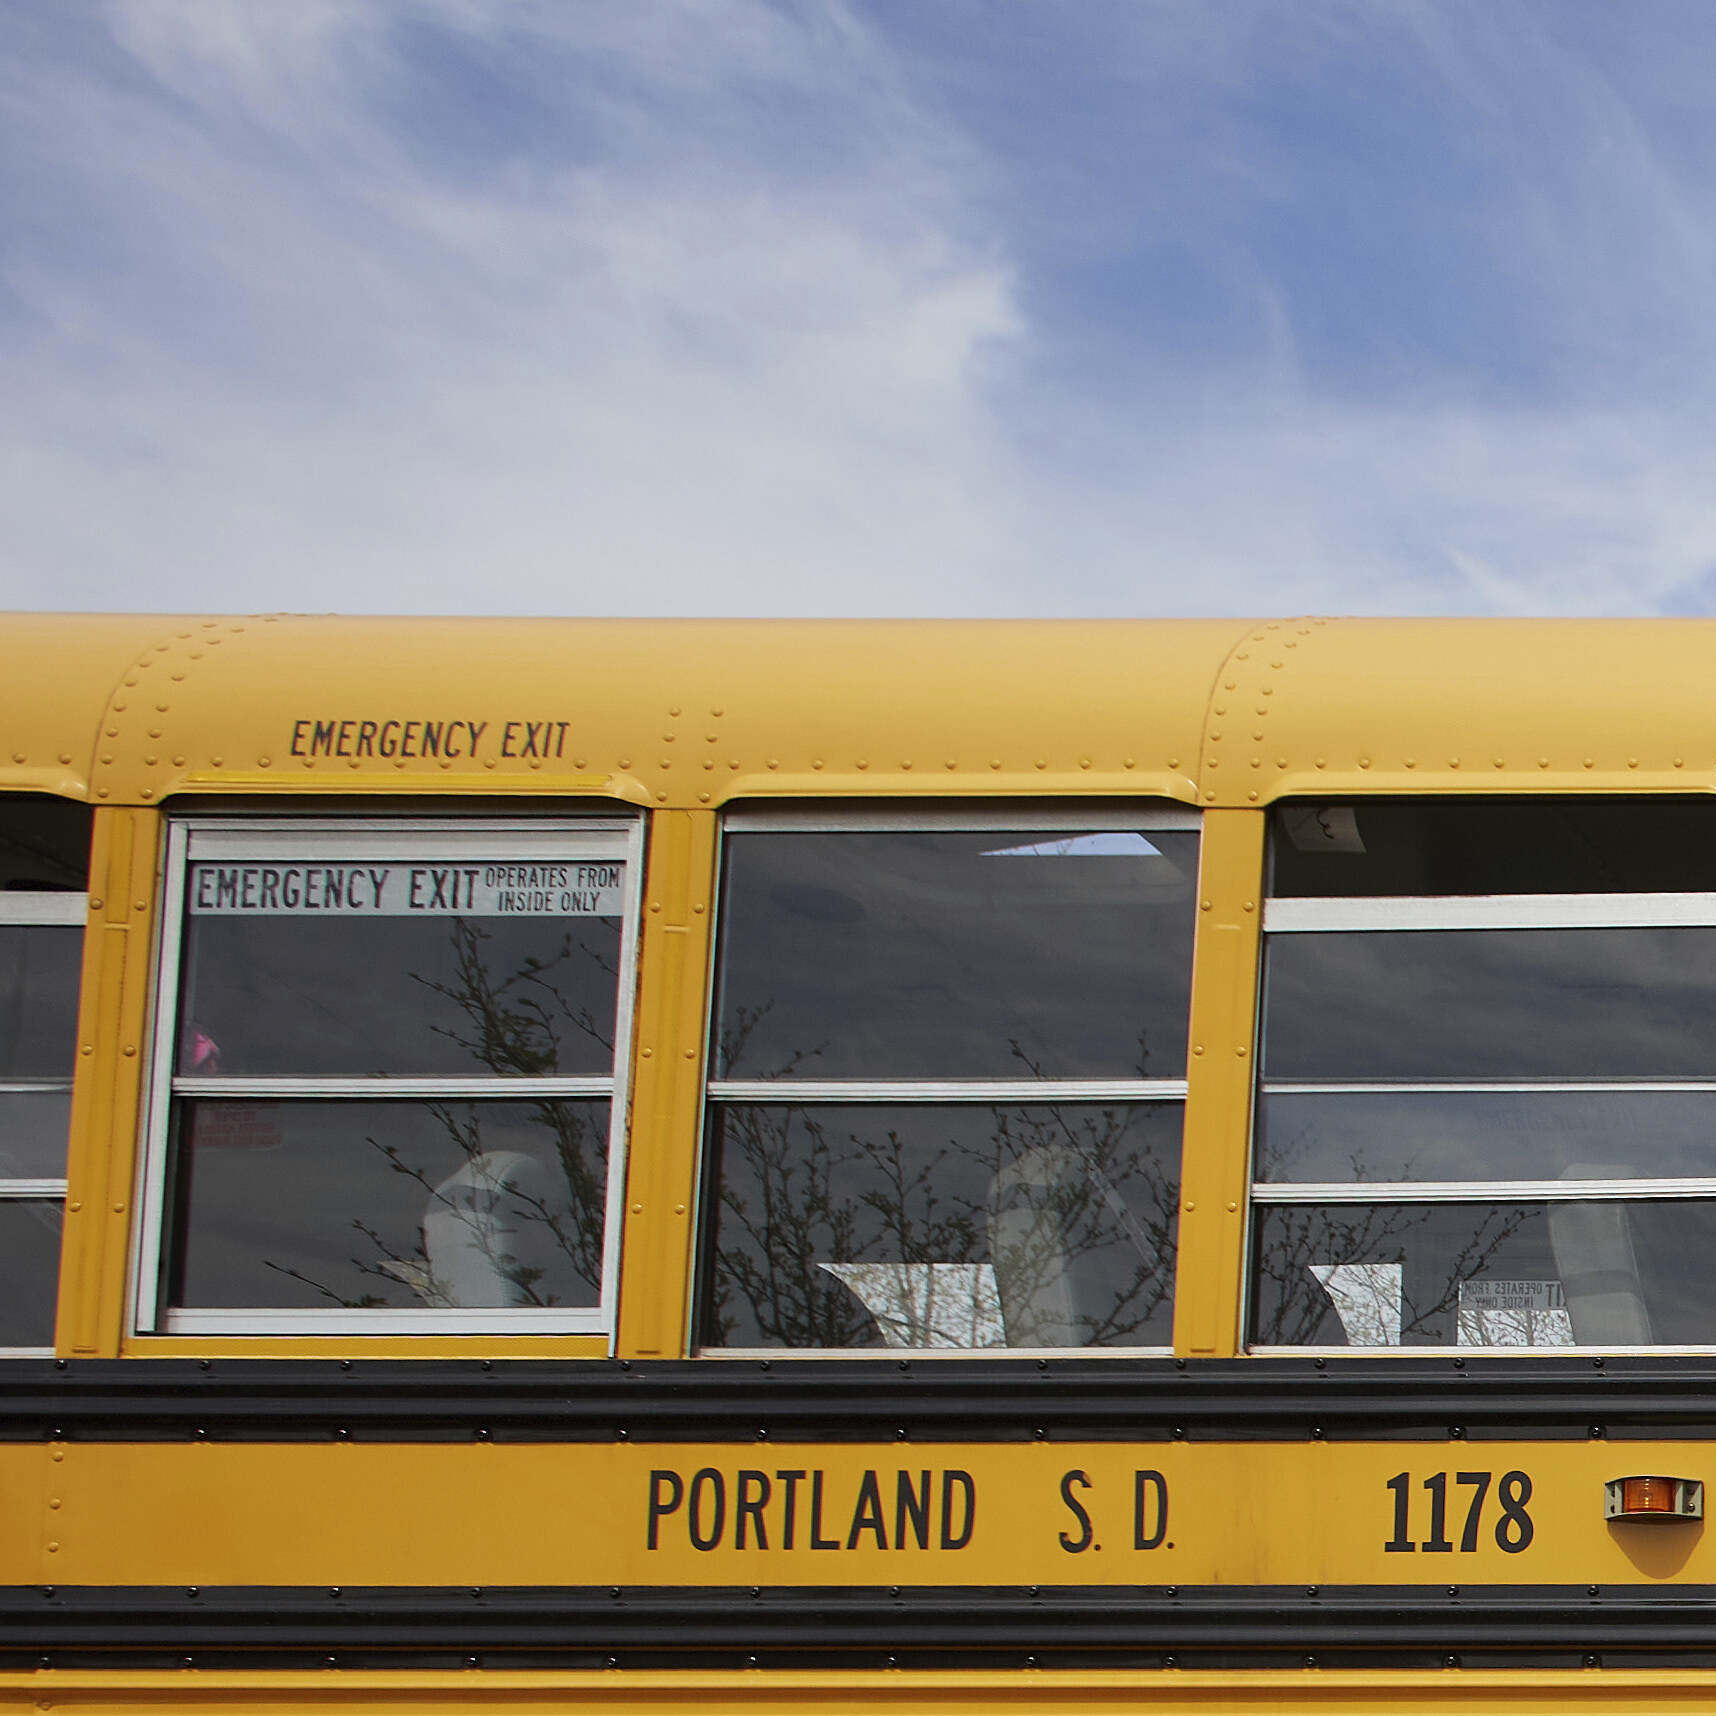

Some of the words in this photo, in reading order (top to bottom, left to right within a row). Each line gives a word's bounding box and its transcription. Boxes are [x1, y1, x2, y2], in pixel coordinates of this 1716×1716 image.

[290, 720, 487, 758] EMERGENCY
[501, 721, 570, 758] EXIT
[197, 868, 390, 910] EMERGENCY
[408, 868, 479, 910] EXIT
[485, 866, 569, 889] OPERATES
[578, 867, 620, 889] FROM
[497, 891, 555, 913] INSIDE
[562, 892, 600, 913] ONLY
[646, 1467, 977, 1552] PORTLAND
[1057, 1468, 1102, 1553] S.
[1133, 1469, 1176, 1552] D.
[1383, 1469, 1535, 1554] 1178
